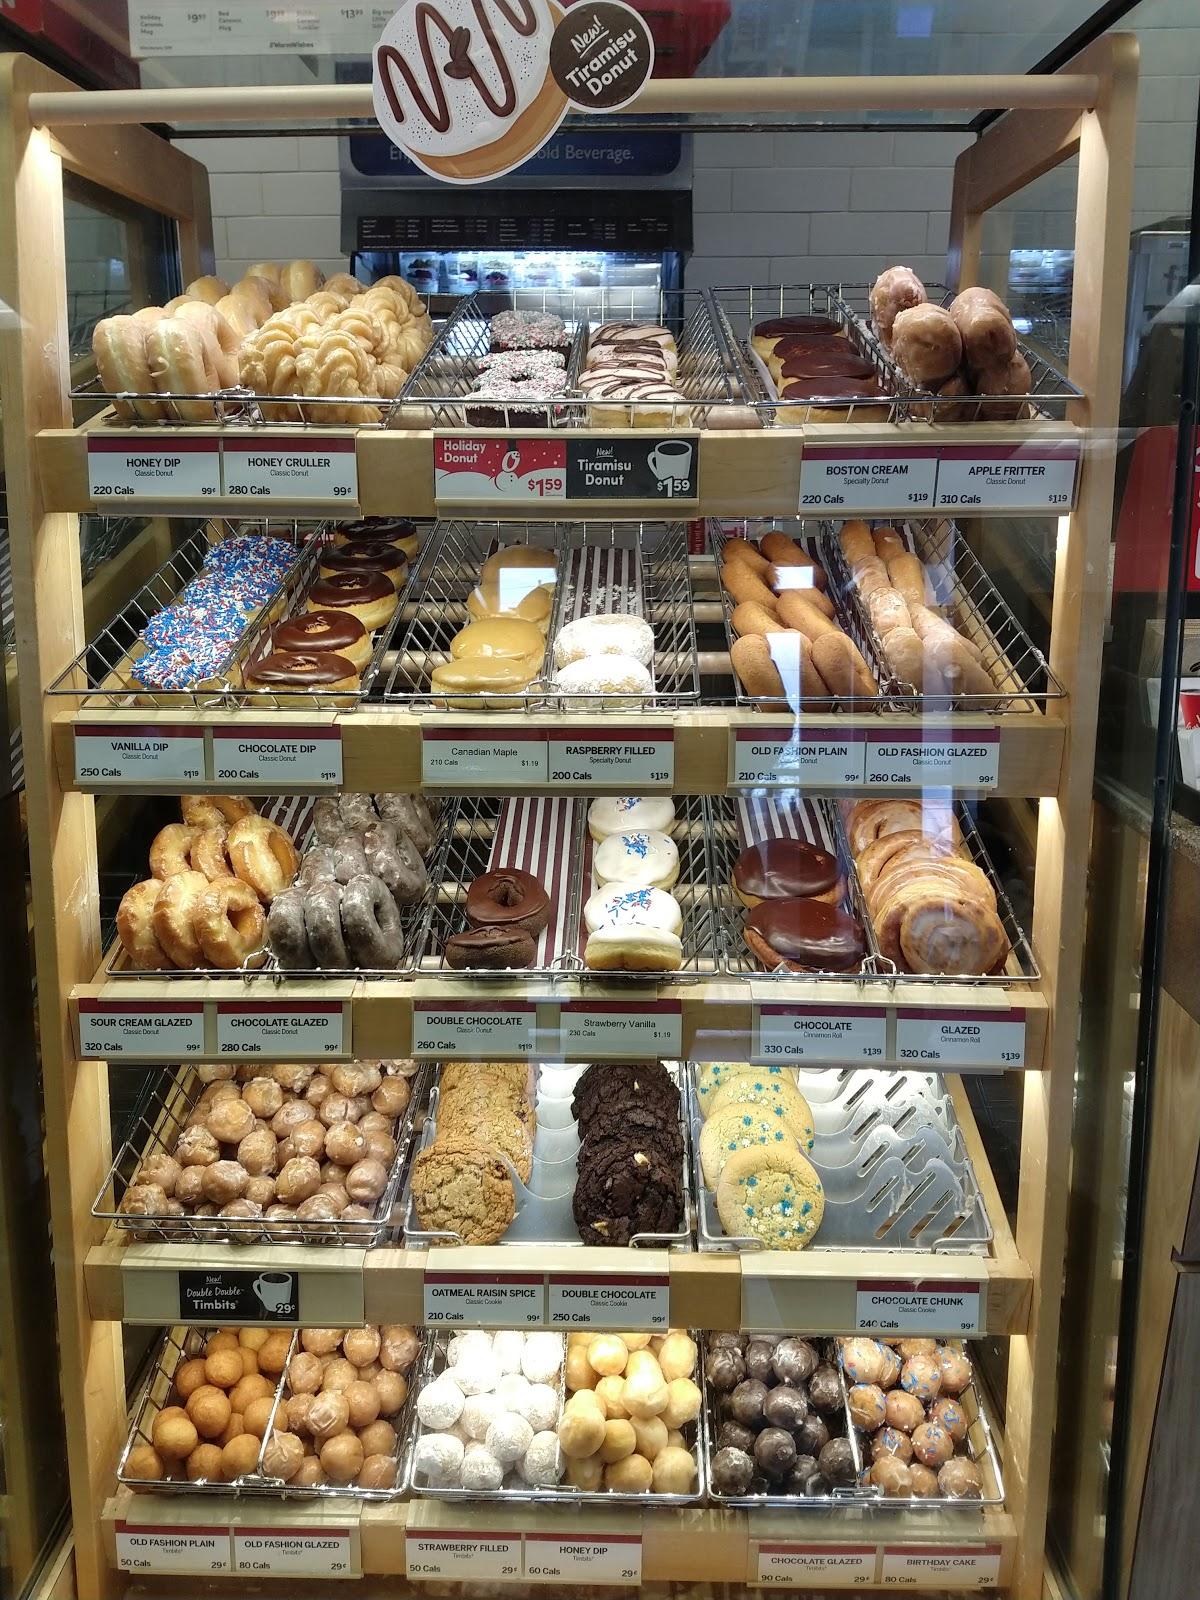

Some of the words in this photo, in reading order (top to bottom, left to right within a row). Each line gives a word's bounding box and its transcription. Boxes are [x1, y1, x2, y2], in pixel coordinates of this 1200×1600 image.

[571, 15, 604, 53] New!
[565, 29, 637, 87] Tiramisu
[586, 49, 638, 96] Donut
[537, 145, 559, 159] old
[444, 440, 486, 454] Holiday
[444, 453, 478, 463] Donut
[126, 459, 161, 468] HONEY
[164, 459, 180, 468] DIP
[248, 458, 283, 467] HONEY
[285, 458, 330, 468] CRULLER
[577, 459, 632, 471] Tiramisu
[826, 466, 869, 476] BOSTON
[871, 465, 908, 475] CREAM
[968, 466, 1001, 476] APPLE
[1003, 466, 1045, 476] FRITTER
[585, 474, 624, 486] Donut
[843, 477, 870, 485] Specialty
[871, 477, 889, 485] Donut
[986, 477, 1006, 485] Classic
[1007, 477, 1026, 485] Donut
[94, 486, 112, 495] 220
[114, 486, 135, 495] Cals
[229, 486, 248, 495] 280
[250, 486, 271, 495] Cals
[802, 495, 821, 504] 220
[824, 495, 844, 503] Cals
[940, 495, 958, 504] 310
[960, 494, 981, 504] Cals
[111, 742, 150, 751] VANILLA
[152, 743, 169, 751] DIP
[238, 744, 298, 753] CHOCOLATE
[300, 745, 316, 753] DIP
[565, 746, 622, 755] RASPBERRY
[624, 747, 655, 755] FILLED
[451, 748, 491, 756] Canadian
[493, 748, 518, 757] Maple
[751, 747, 770, 756] OLD
[819, 747, 847, 756] PLAIN
[878, 748, 897, 757] OLD
[900, 748, 947, 757] FASHION
[949, 748, 987, 757] GLAZED
[913, 758, 932, 766] Classic
[80, 768, 99, 776] 250
[101, 768, 121, 776] Cals
[218, 770, 237, 779] 200
[239, 770, 259, 779] Cals
[552, 772, 571, 780] 200
[573, 771, 592, 780] Cals
[870, 774, 889, 782] 260
[891, 774, 911, 782] Cals
[90, 1018, 116, 1027] SOUR
[118, 1019, 152, 1027] CREAM
[154, 1019, 192, 1027] GLAZED
[230, 1019, 289, 1027] CHOCOLATE
[291, 1019, 328, 1027] GLAZED
[427, 1017, 464, 1025] DOUBLE
[466, 1017, 522, 1025] CHOCOLATE
[584, 1019, 626, 1029] Strawberry
[629, 1019, 656, 1028] Vanilla
[794, 1021, 852, 1031] CHOCOLATE
[941, 1026, 980, 1035] GLAZED
[84, 1043, 102, 1051] 320
[104, 1042, 123, 1051] Cals
[221, 1043, 239, 1052] 280
[241, 1043, 261, 1052] Cals
[417, 1041, 435, 1049] 260
[437, 1041, 456, 1049] Cals
[764, 1045, 782, 1054] 330
[784, 1045, 804, 1054] Cals
[900, 1049, 919, 1058] 320
[921, 1050, 940, 1059] Cals
[187, 1288, 213, 1297] Double
[215, 1287, 240, 1296] Double
[432, 1289, 474, 1297] OATMEAL
[476, 1289, 507, 1297] RAISIN
[509, 1290, 536, 1298] SPICE
[562, 1290, 598, 1298] DOUBLE
[601, 1291, 656, 1299] CHOCOLATE
[193, 1300, 235, 1309] Timbits
[871, 1296, 927, 1305] CHOCOLATE
[930, 1297, 963, 1306] CHUNK
[428, 1312, 444, 1320] 210
[446, 1312, 464, 1320] Cals
[553, 1313, 570, 1321] 250
[572, 1313, 590, 1322] Cals
[880, 1320, 899, 1328] Cals
[130, 1538, 148, 1546] OLD
[149, 1538, 187, 1547] FASHION
[189, 1539, 215, 1547] PLAIN
[245, 1540, 262, 1548] OLD
[264, 1541, 303, 1549] FASHION
[305, 1541, 339, 1549] GLAZED
[480, 1544, 508, 1552] FILLED
[559, 1546, 591, 1554] HONEY
[593, 1547, 608, 1555] DIP
[134, 1559, 151, 1567] Cals
[239, 1561, 251, 1569] 80
[253, 1561, 270, 1569] Cals
[542, 1567, 560, 1575] Cals
